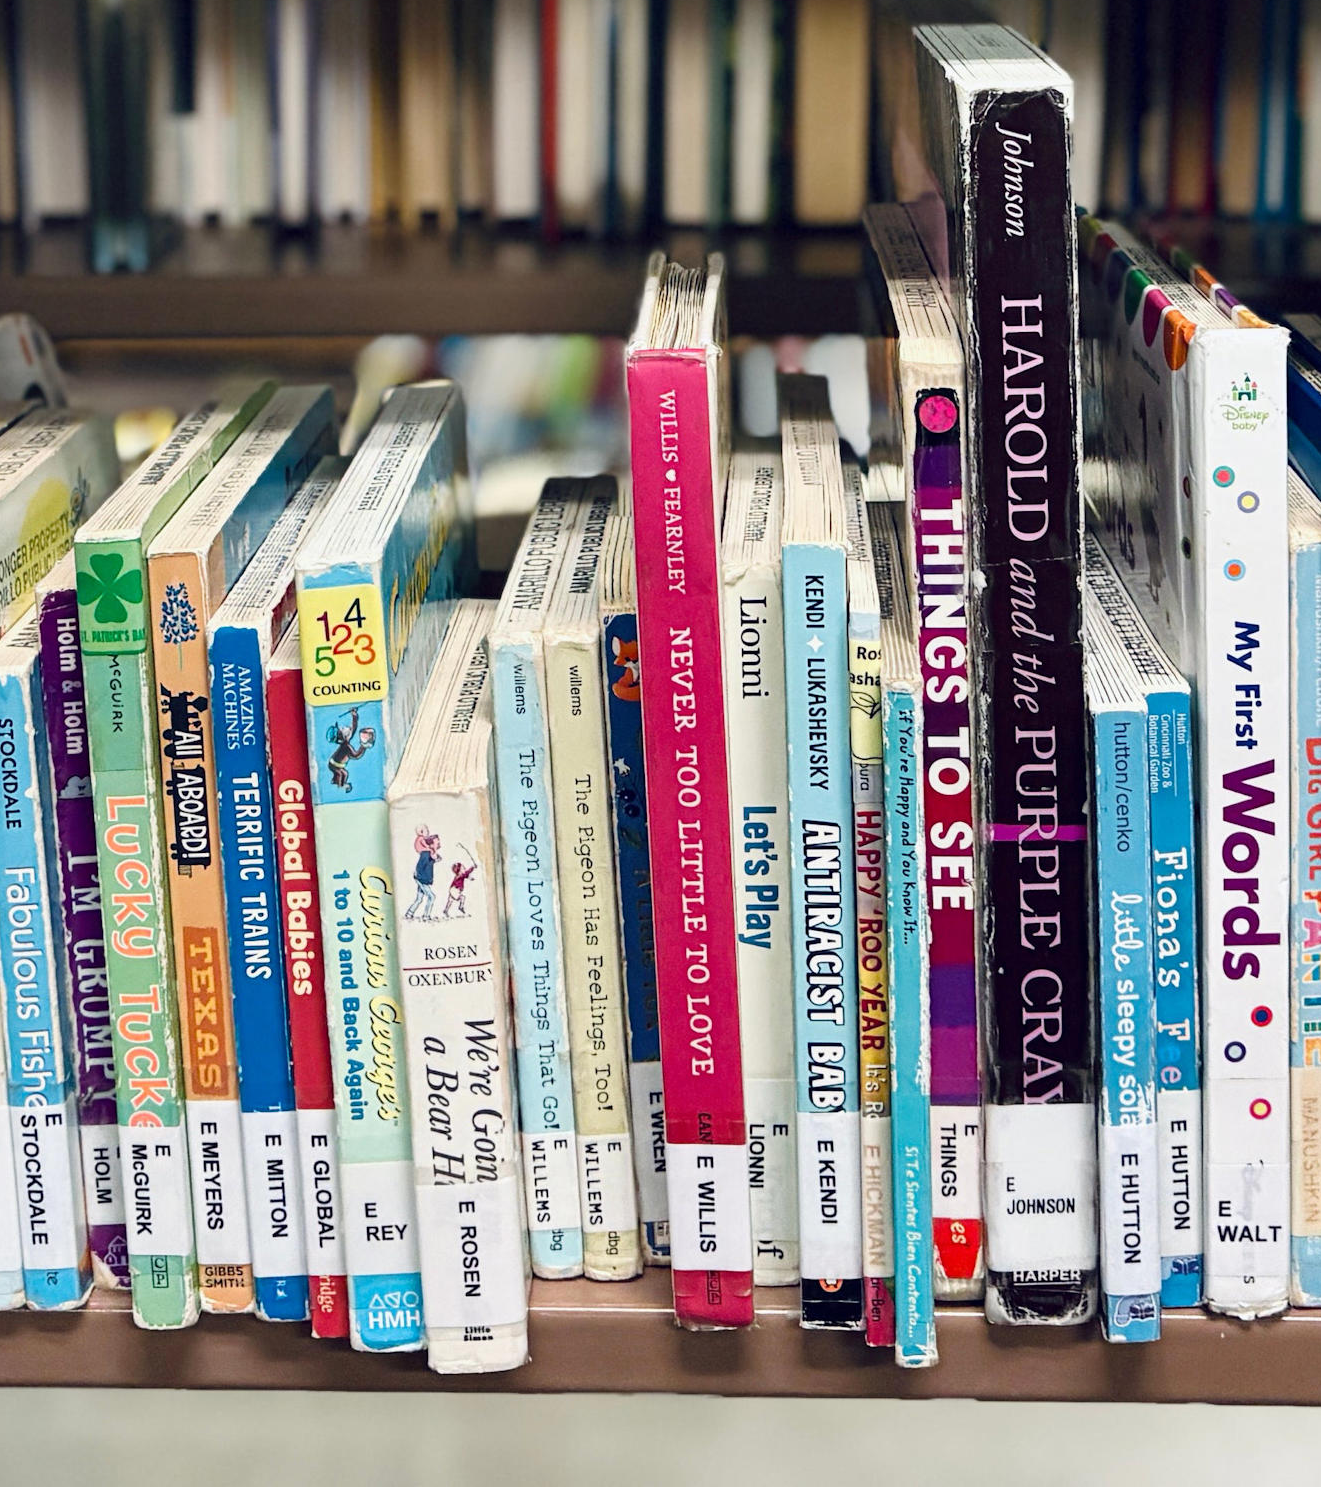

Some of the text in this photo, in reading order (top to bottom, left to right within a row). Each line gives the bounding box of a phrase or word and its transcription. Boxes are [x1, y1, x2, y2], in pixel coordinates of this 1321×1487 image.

[995, 121, 1032, 237] Johnson
[658, 390, 685, 595] WILLIS FEARNLEY
[740, 595, 769, 698] Lionni
[1000, 294, 1061, 949] HAROLD and the PURPLE
[221, 663, 240, 750] MACHINES
[238, 665, 256, 746] AMAZING
[312, 679, 381, 697] COUNTING
[805, 574, 828, 791] KENDI LUKASHEVSKY
[920, 499, 974, 911] THINGS TO SEE
[176, 766, 209, 863] ABOARD!
[1114, 722, 1132, 852] hutton/cenko
[1222, 622, 1280, 980] My First Words
[231, 772, 271, 980] TERRIFIC TRAINS
[278, 779, 313, 996] Global Babies
[669, 627, 714, 1076] NEVER TOO LITTLE TO LOVE
[801, 819, 844, 1025] ANTIRACIST
[1155, 848, 1189, 988] Fiona's
[189, 937, 221, 1089] TEXAS
[20, 1114, 49, 1246] STOCKDALE
[132, 1143, 152, 1236] McGUIRK
[201, 1142, 224, 1230] MEYERS
[266, 1159, 289, 1238] MITTON
[698, 1181, 717, 1253] WILLIS
[816, 1164, 838, 1225] KENDI
[1006, 1197, 1075, 1215] JOHNSON
[1121, 1174, 1140, 1265] HUTTON
[205, 1266, 244, 1277] GIBBS
[205, 1277, 244, 1288] SMITH
[1217, 1225, 1281, 1243] WALT
[369, 1311, 421, 1328] HMH
